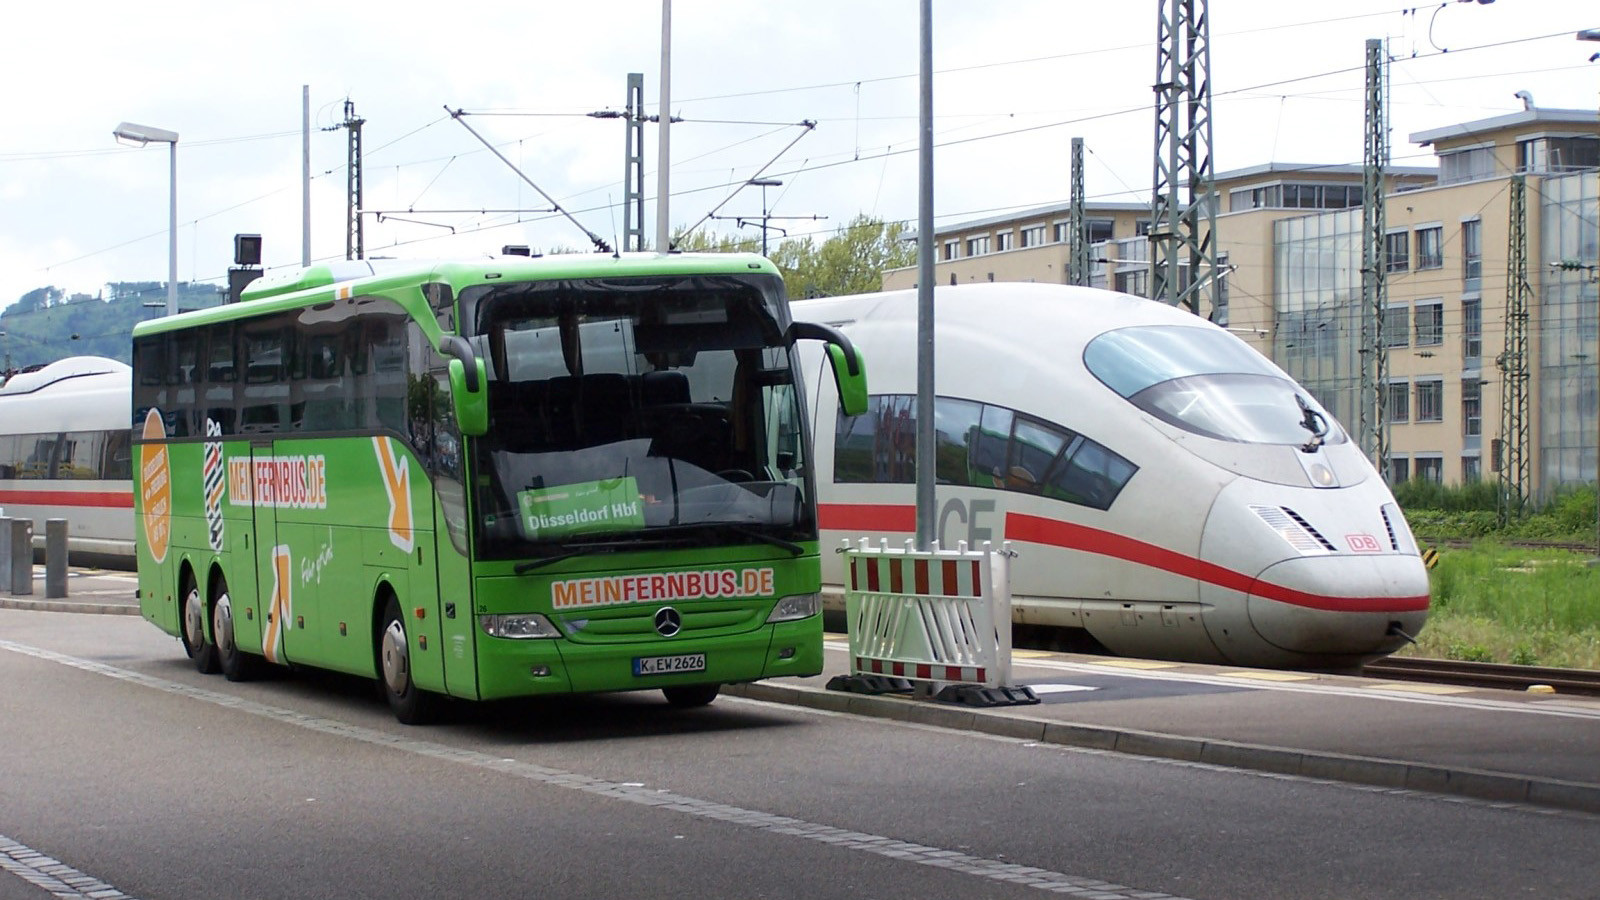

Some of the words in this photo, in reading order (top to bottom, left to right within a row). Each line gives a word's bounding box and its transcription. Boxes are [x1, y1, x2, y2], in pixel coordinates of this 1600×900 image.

[229, 459, 325, 503] MEINFERNBUS.DE
[527, 505, 608, 531] Düsseldorf
[611, 501, 638, 518] Hbf
[934, 498, 996, 551] CE
[1348, 536, 1378, 550] DB
[553, 569, 773, 607] MEINFERNBUS.DE
[641, 660, 649, 672] K
